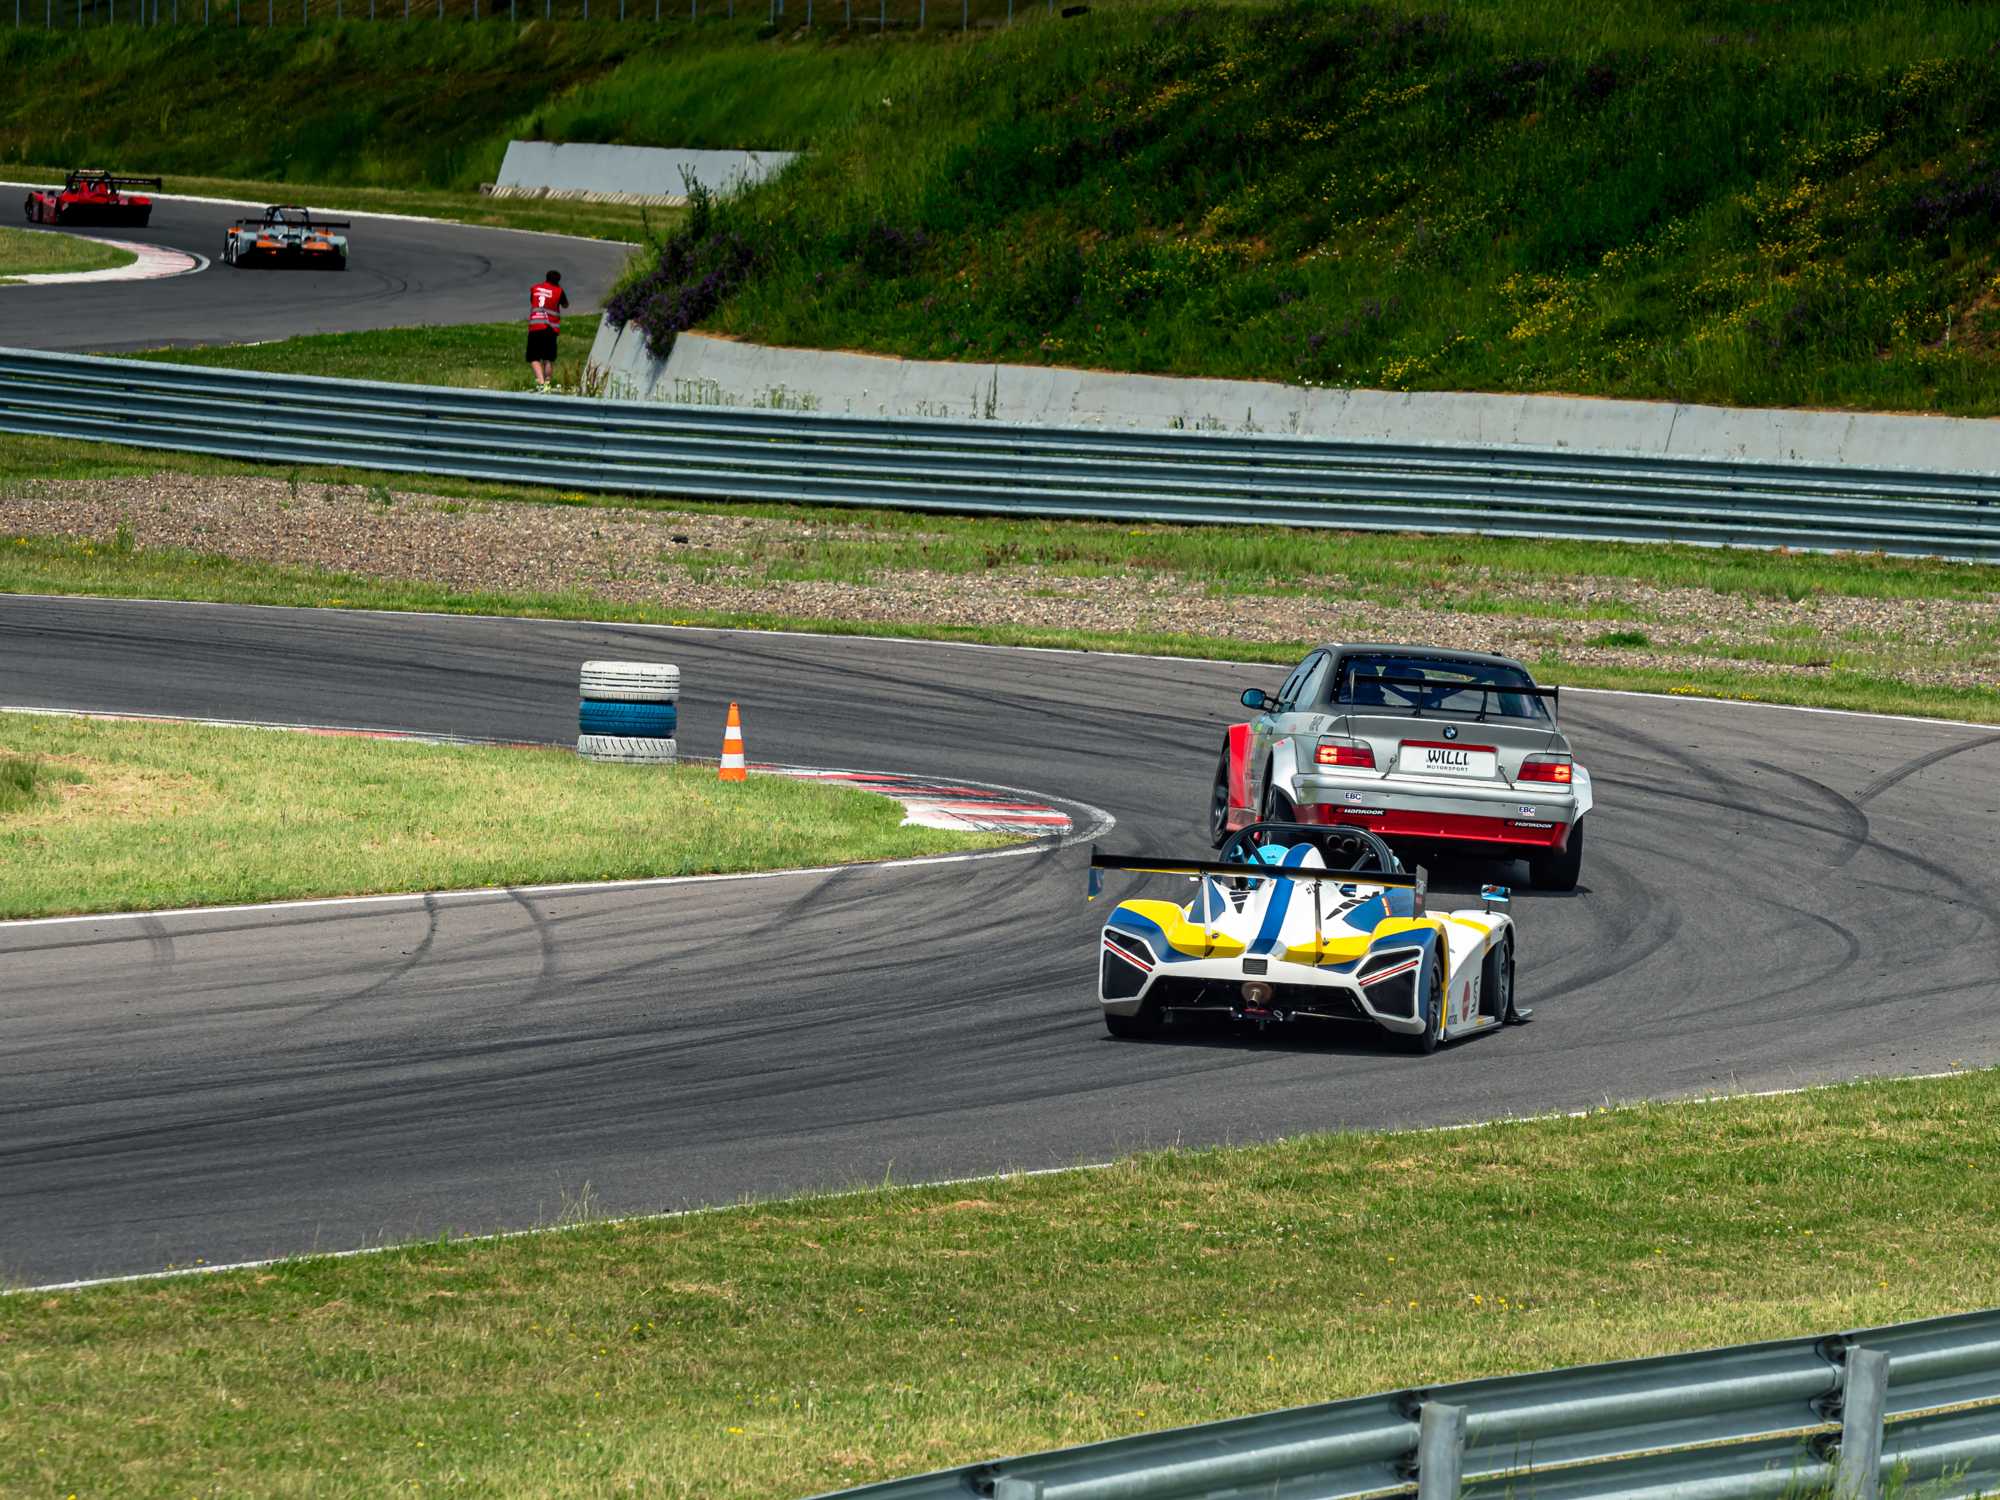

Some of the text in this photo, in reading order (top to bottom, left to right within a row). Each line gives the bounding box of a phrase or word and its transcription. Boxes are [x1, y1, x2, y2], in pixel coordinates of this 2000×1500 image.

[1428, 750, 1468, 765] WILLI
[1427, 764, 1468, 772] MOTORSPORT
[1345, 792, 1361, 800] EBC
